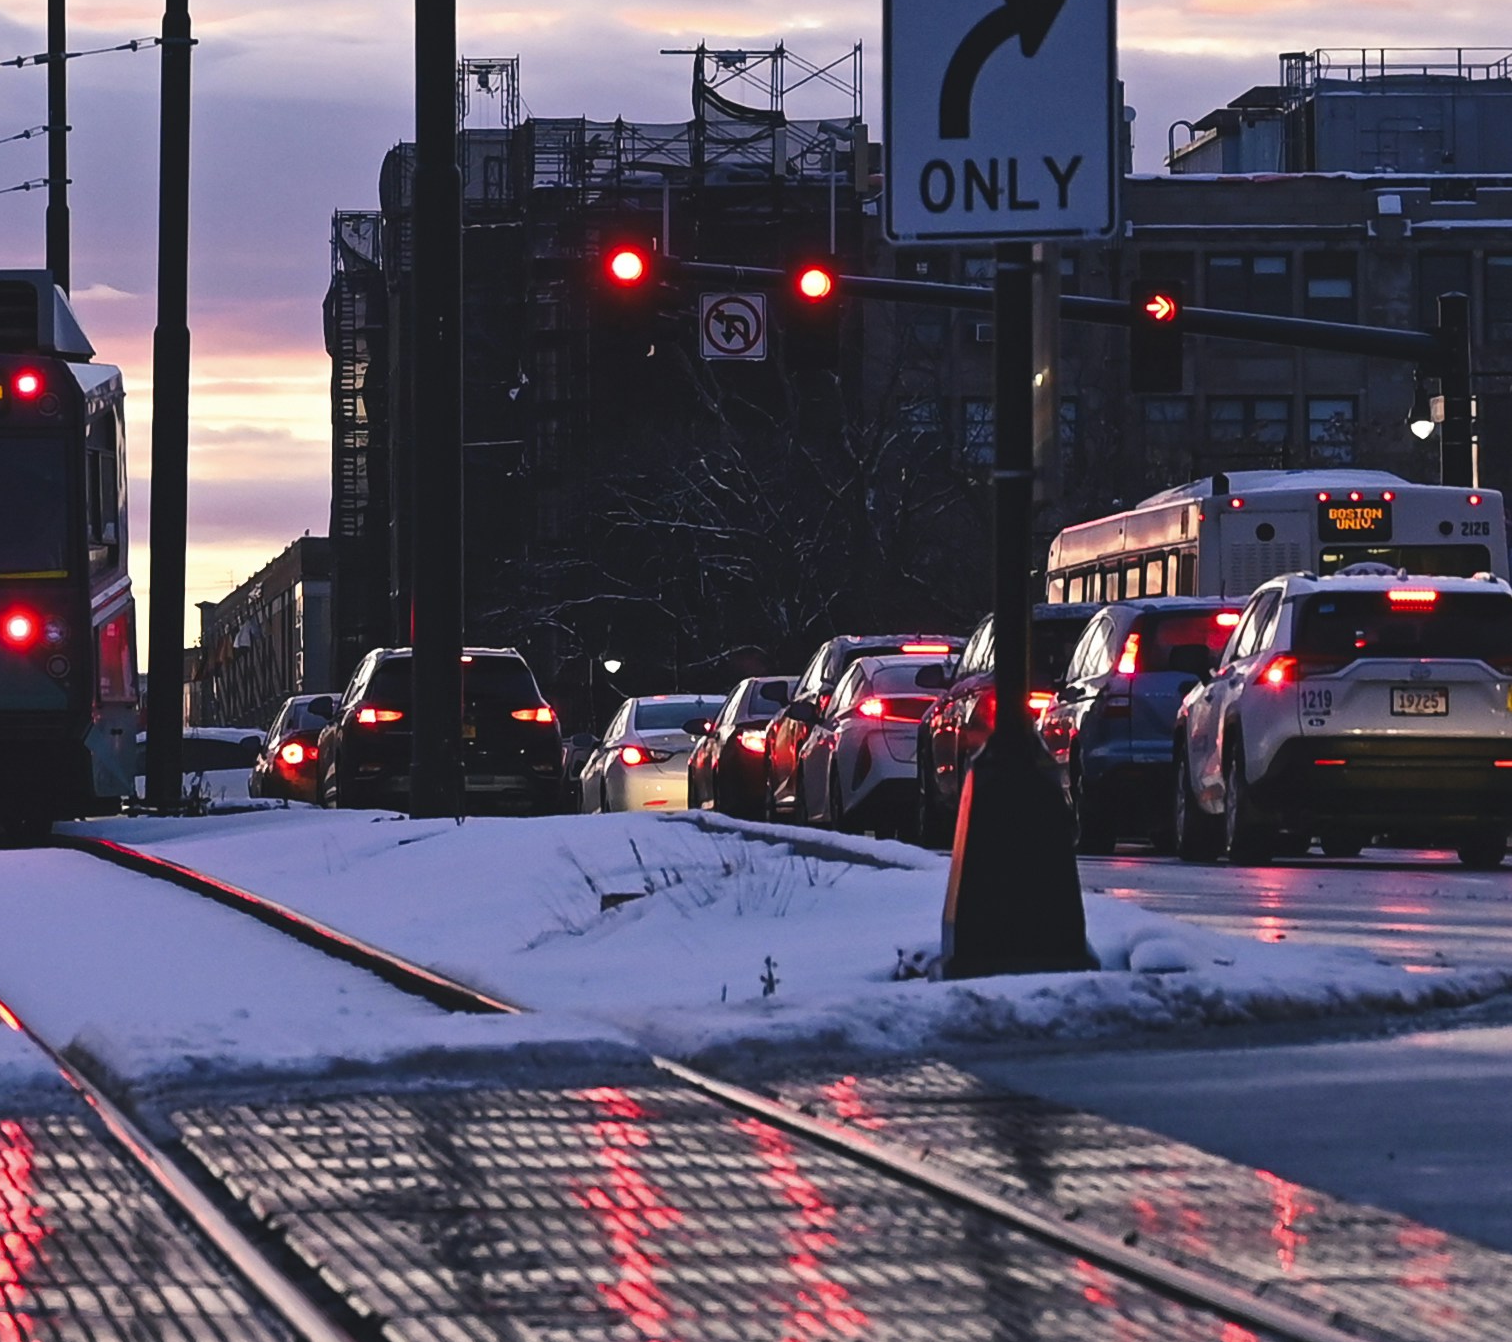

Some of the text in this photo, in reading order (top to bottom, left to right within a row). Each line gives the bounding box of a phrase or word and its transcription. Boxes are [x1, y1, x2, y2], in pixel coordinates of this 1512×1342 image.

[920, 155, 1083, 213] ONLY
[1329, 508, 1383, 520] BOSTON
[1336, 519, 1375, 530] UNIV.
[1301, 689, 1333, 708] 1219
